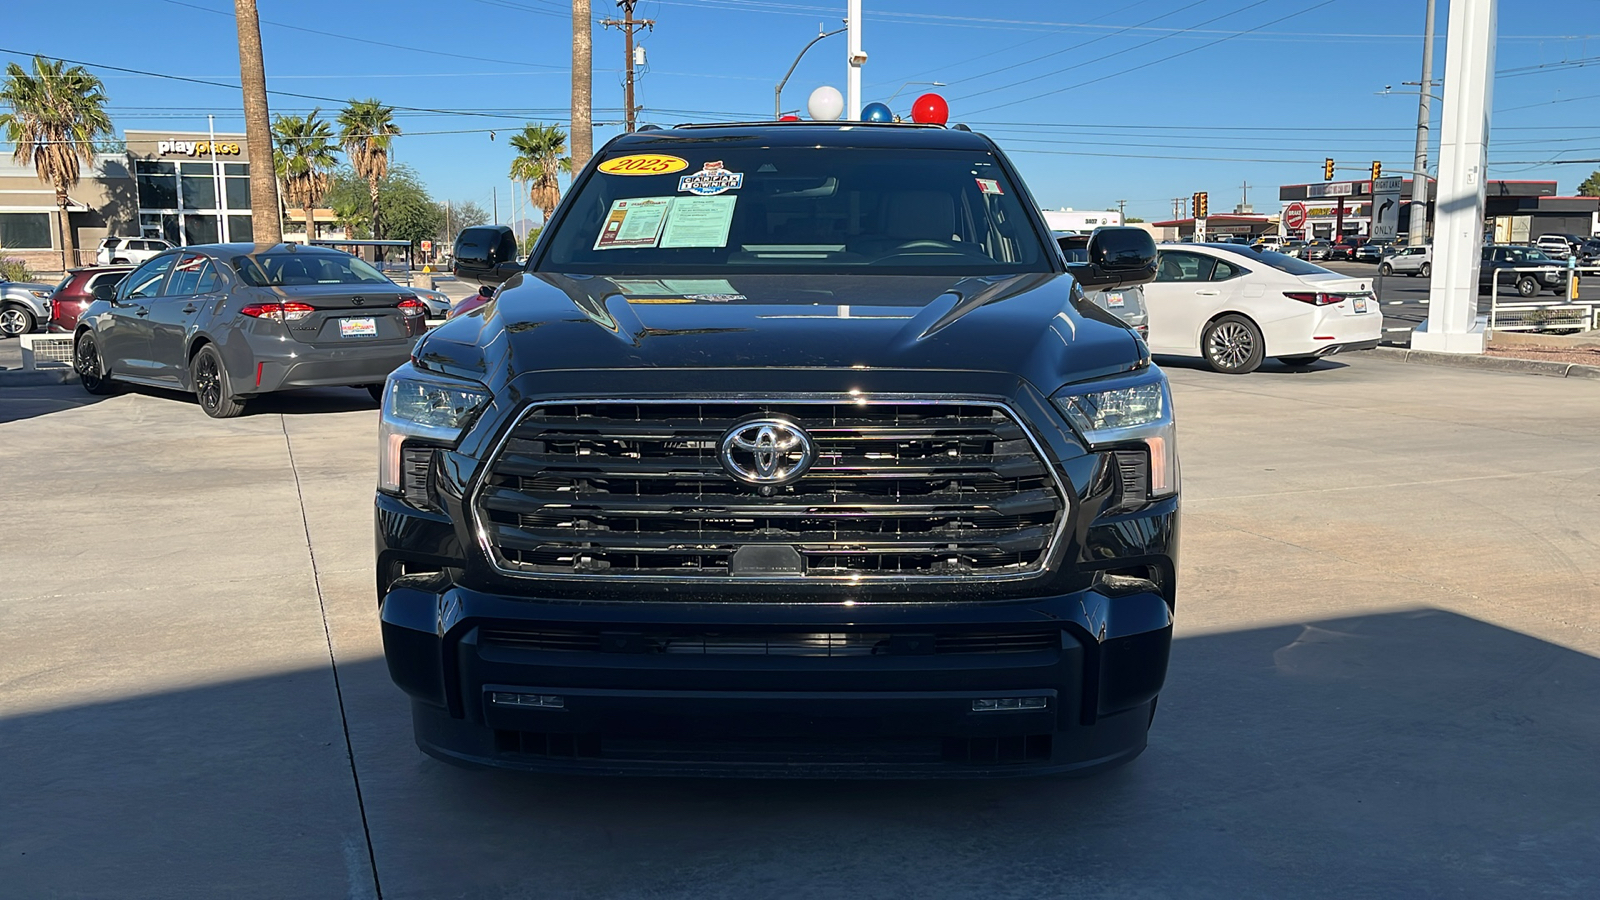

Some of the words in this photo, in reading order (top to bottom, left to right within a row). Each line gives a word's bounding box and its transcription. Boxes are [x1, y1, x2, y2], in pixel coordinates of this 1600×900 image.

[157, 138, 240, 157] playplace
[609, 158, 677, 171] 2025
[1375, 181, 1388, 189] RIGHT
[1389, 180, 1401, 188] LANE
[1374, 225, 1394, 235] ONLY
